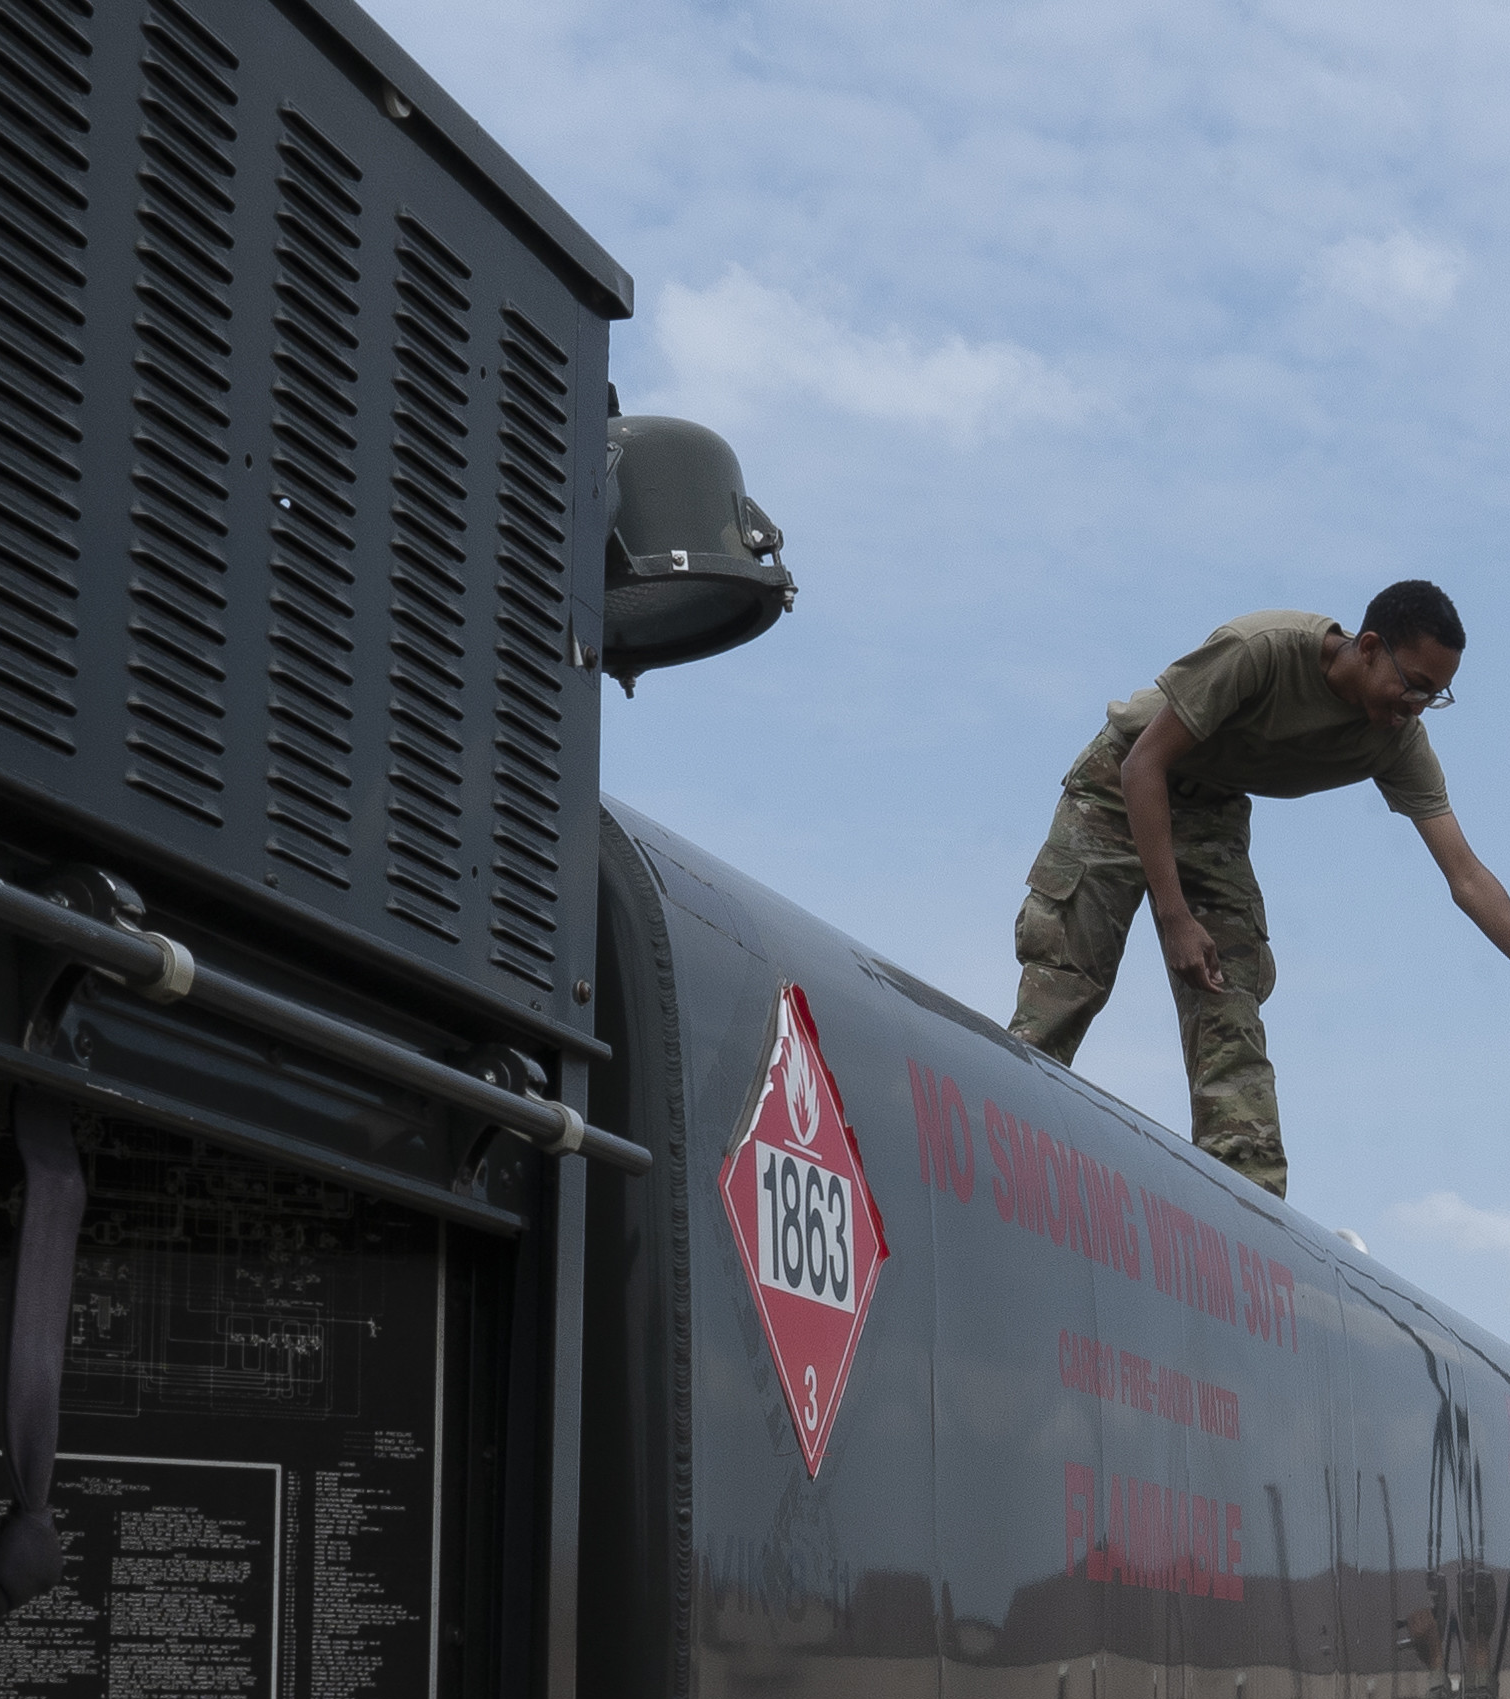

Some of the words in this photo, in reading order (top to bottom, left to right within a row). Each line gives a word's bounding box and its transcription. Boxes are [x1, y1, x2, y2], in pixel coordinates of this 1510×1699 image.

[764, 1152, 850, 1302] 1863
[907, 1057, 975, 1205] NO
[984, 1098, 1141, 1281] SMOKING
[1140, 1186, 1237, 1327] WITHIN
[804, 1365, 818, 1432] 3
[1059, 1328, 1115, 1401] CARGO
[1196, 1379, 1241, 1441] WATER
[1064, 1459, 1245, 1602] FLAMMABLE
